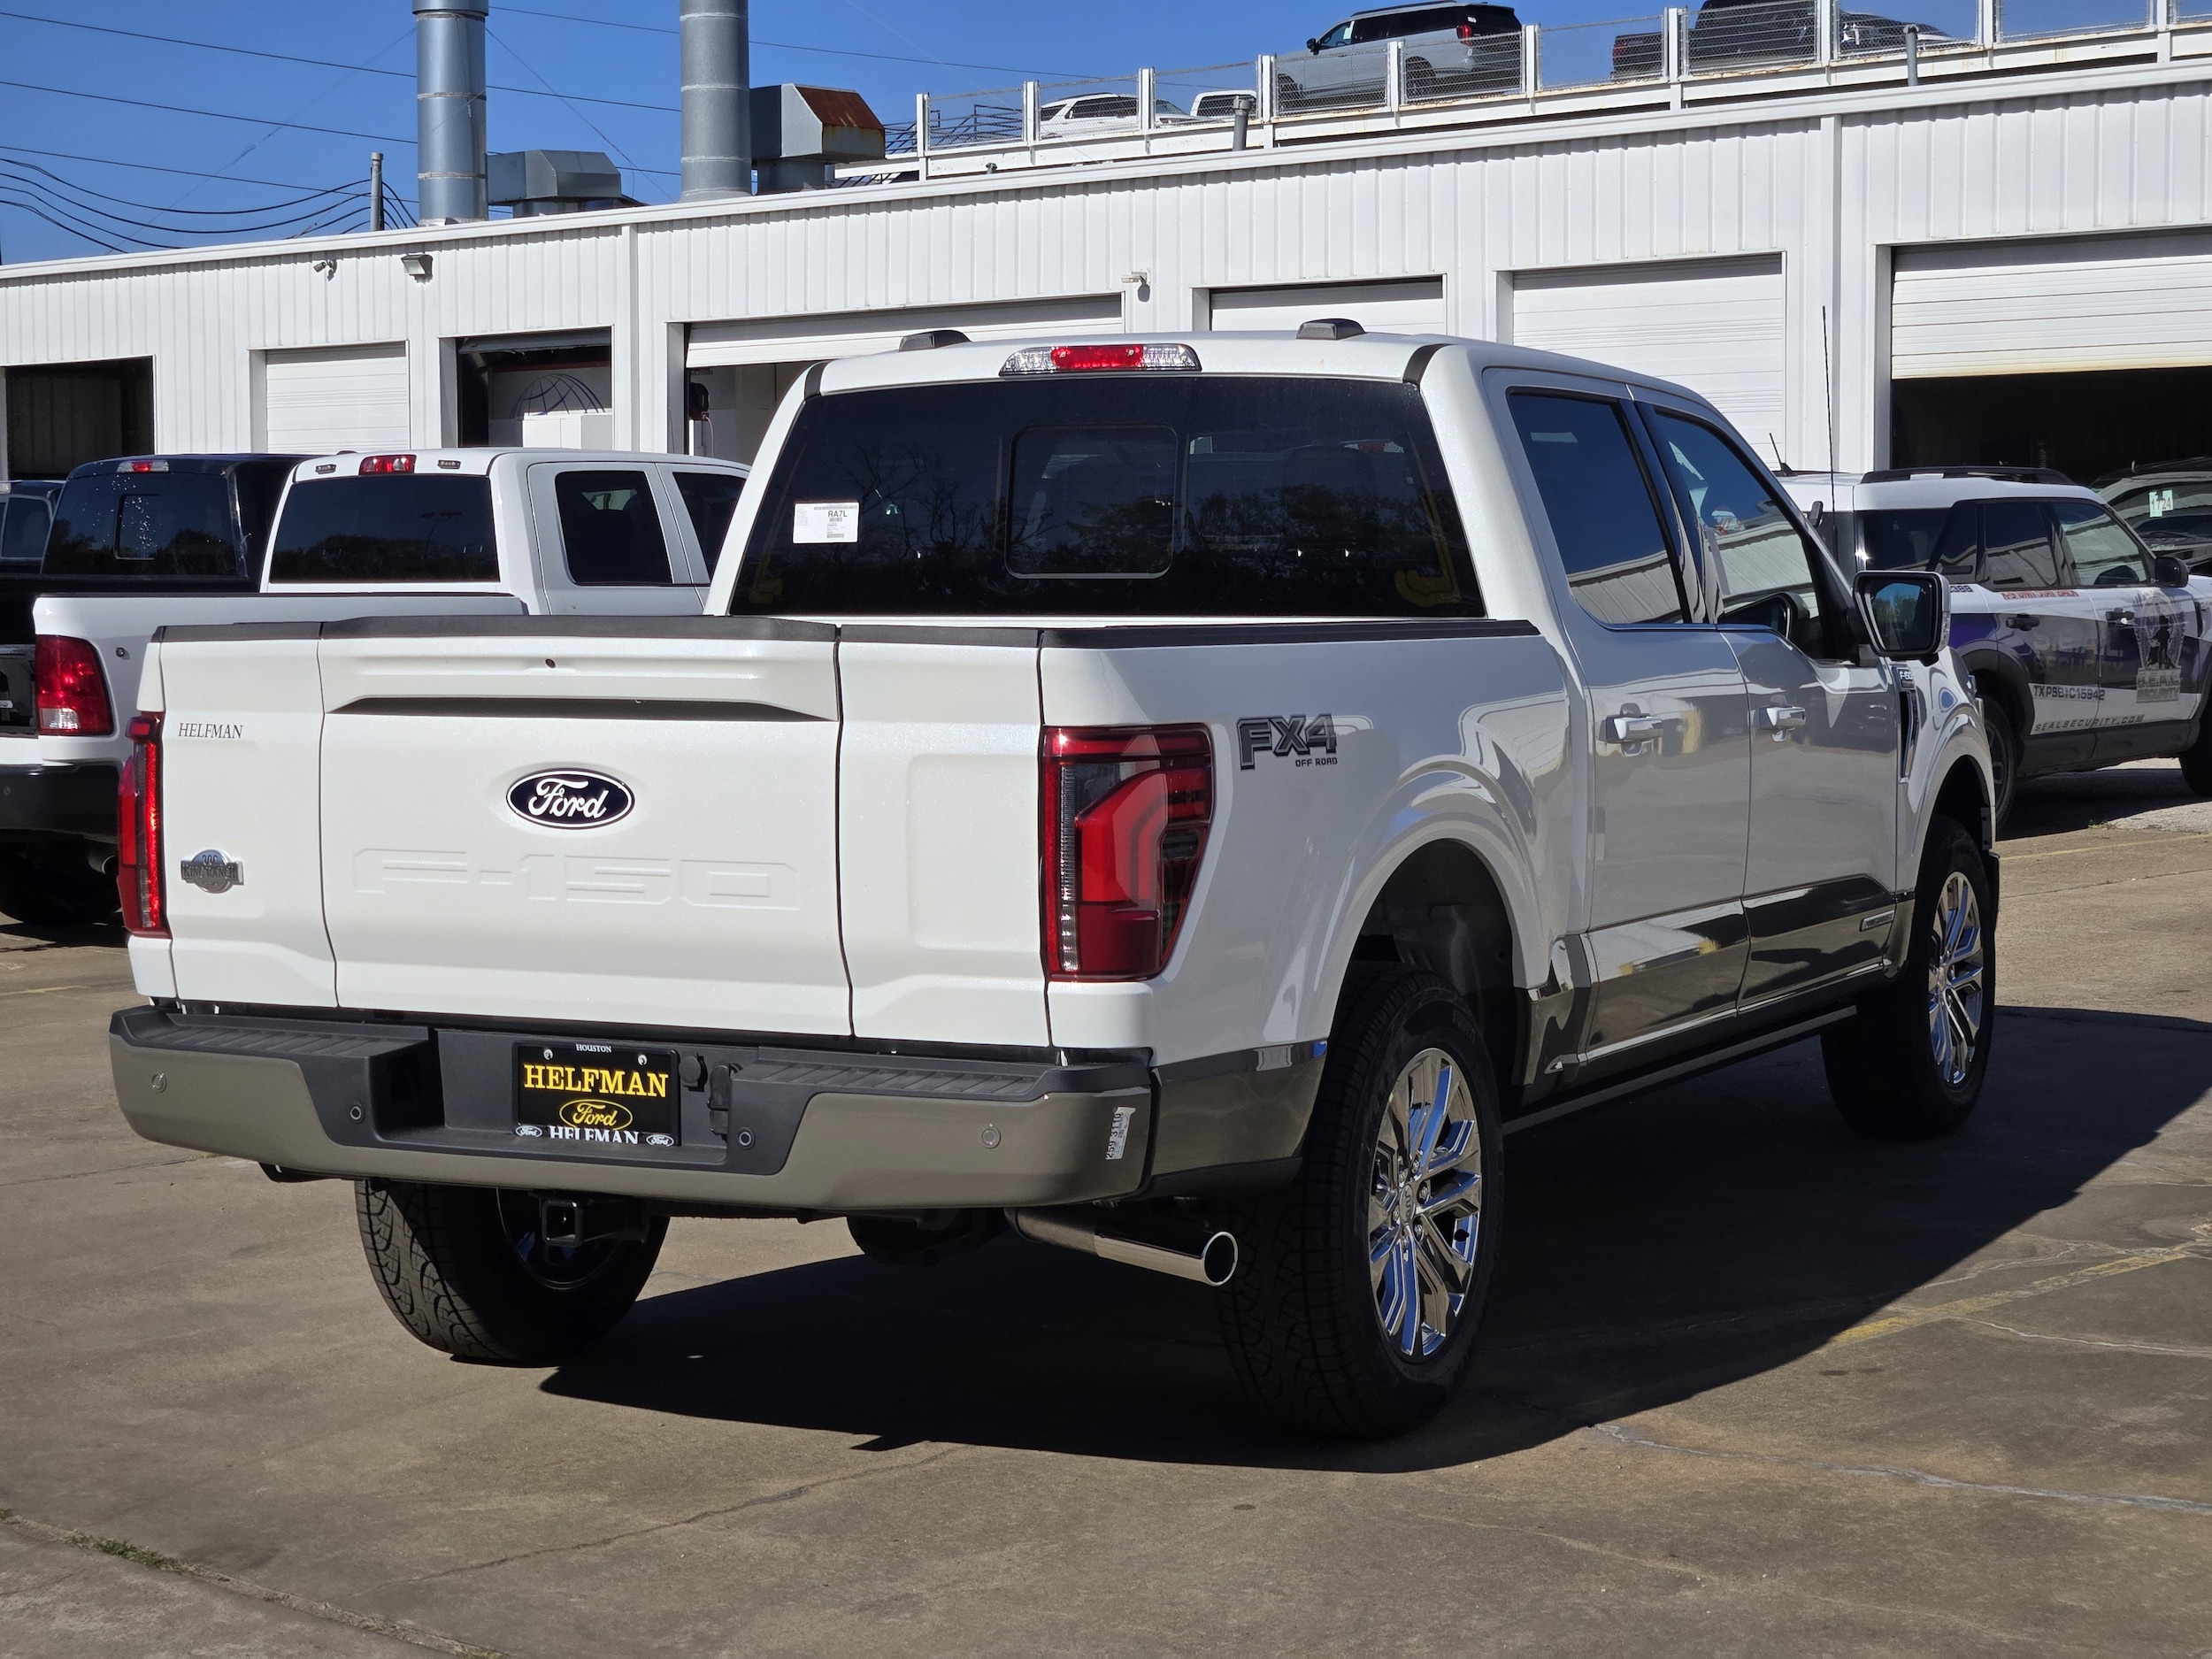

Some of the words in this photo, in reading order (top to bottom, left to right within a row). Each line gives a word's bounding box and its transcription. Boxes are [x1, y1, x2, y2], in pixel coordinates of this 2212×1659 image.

[177, 722, 244, 740] HELFMAN
[2034, 714, 2145, 732] SEALSECURITY.COM
[1236, 713, 1337, 771] FX4
[1295, 758, 1313, 767] OFF
[1315, 757, 1338, 766] ROAD
[527, 778, 610, 818] Ford
[183, 864, 205, 878] KING
[206, 864, 236, 879] RANCH
[575, 1043, 612, 1053] HOUSTON
[523, 1064, 669, 1098] HELFMAN
[572, 1102, 618, 1126] Ford
[548, 1125, 639, 1145] HELFMAN
